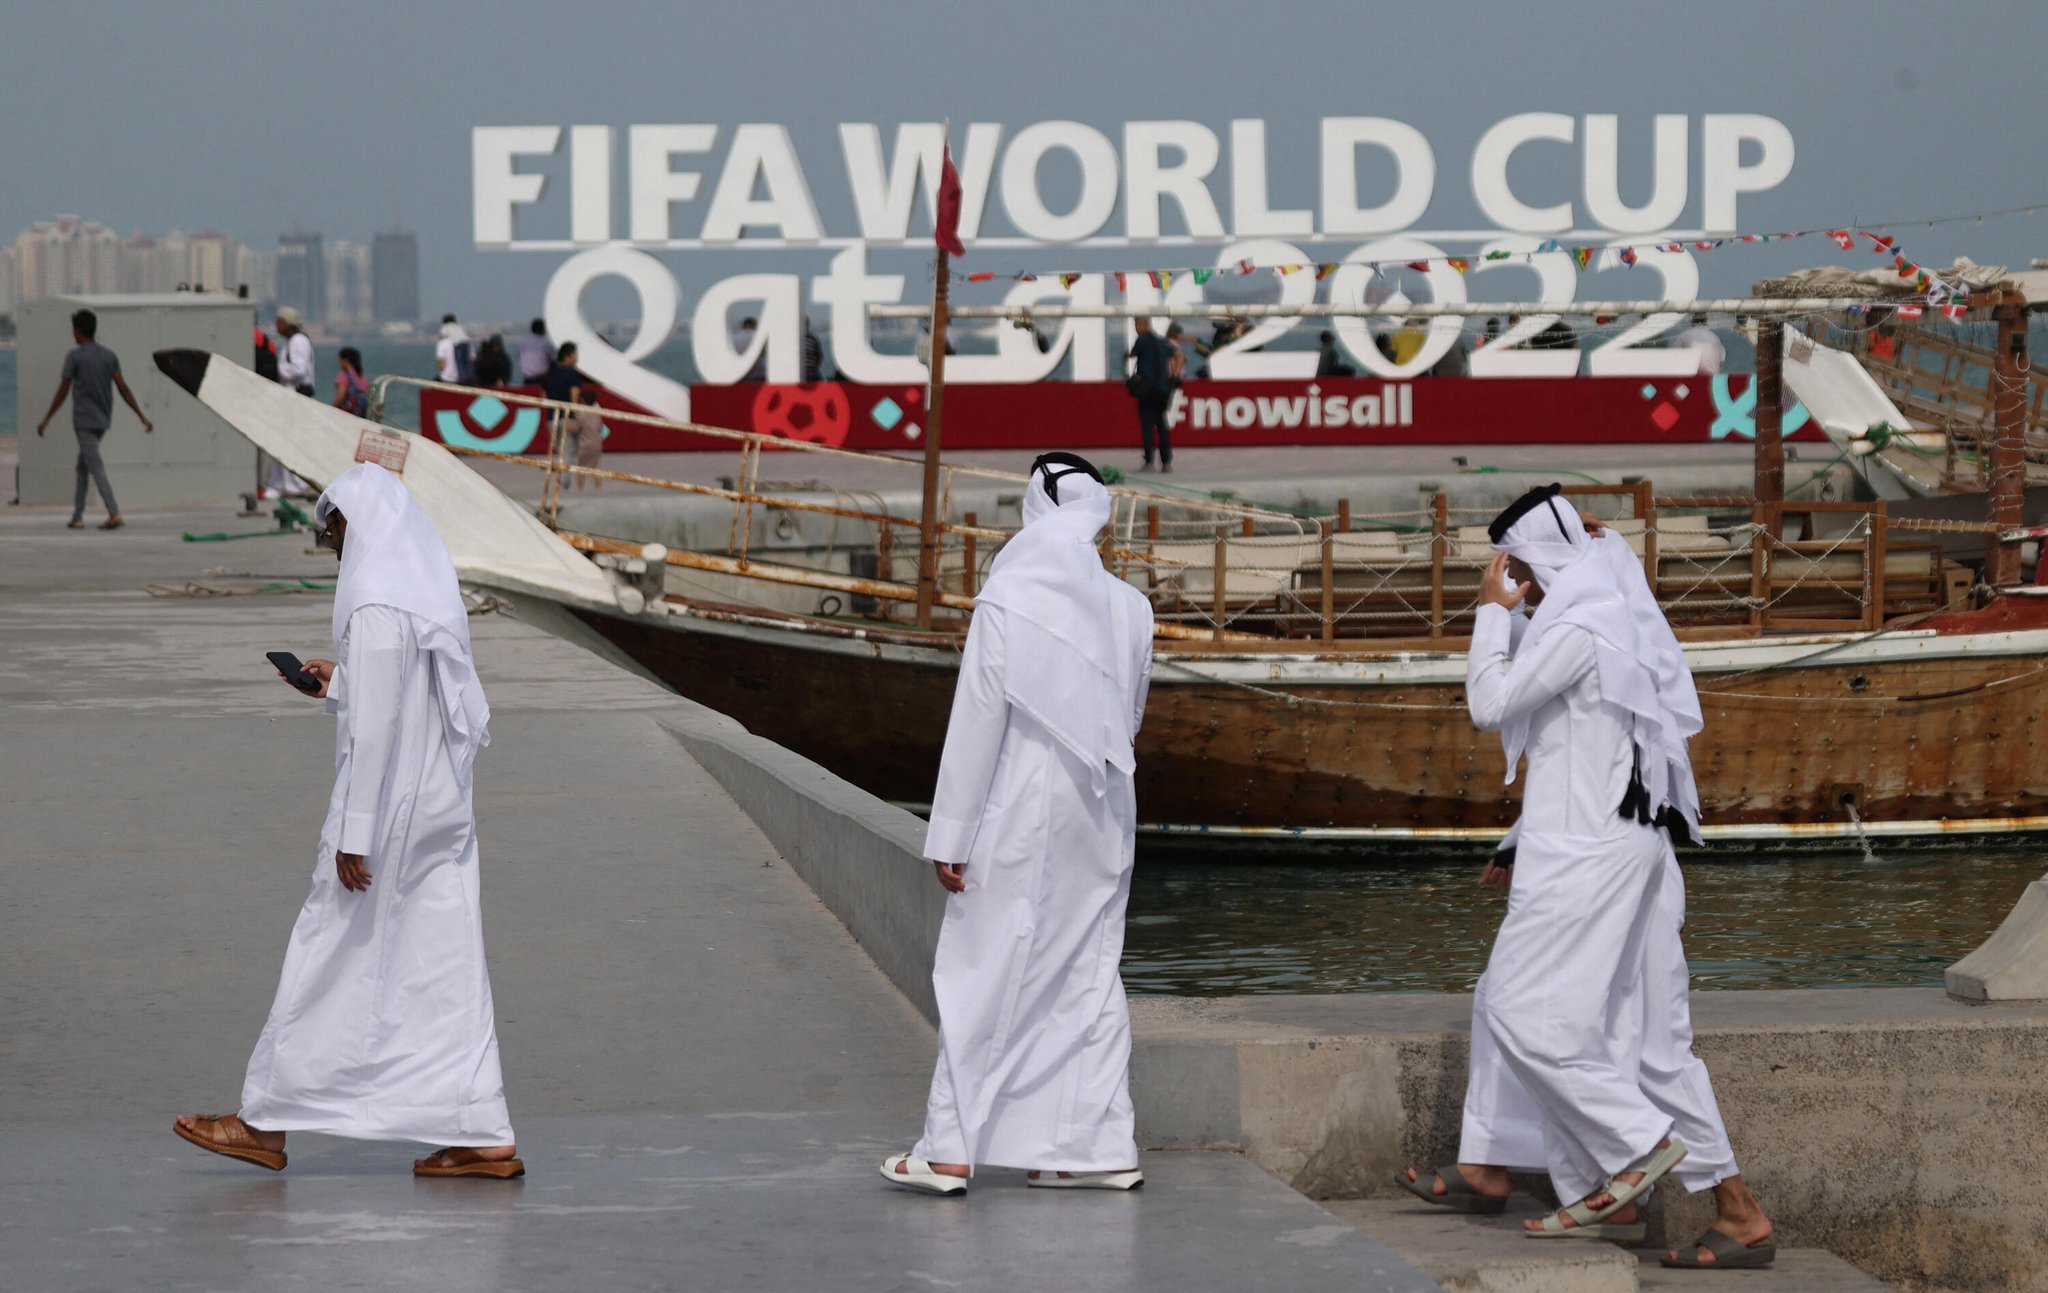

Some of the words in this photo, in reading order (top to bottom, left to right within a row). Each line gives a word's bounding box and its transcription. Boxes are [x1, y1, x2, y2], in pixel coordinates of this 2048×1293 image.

[472, 124, 826, 243] FIFA
[838, 115, 1436, 242] WORLD
[1471, 112, 1796, 234] CUP
[543, 243, 1205, 422] Qatar
[1209, 237, 1701, 380] 2022
